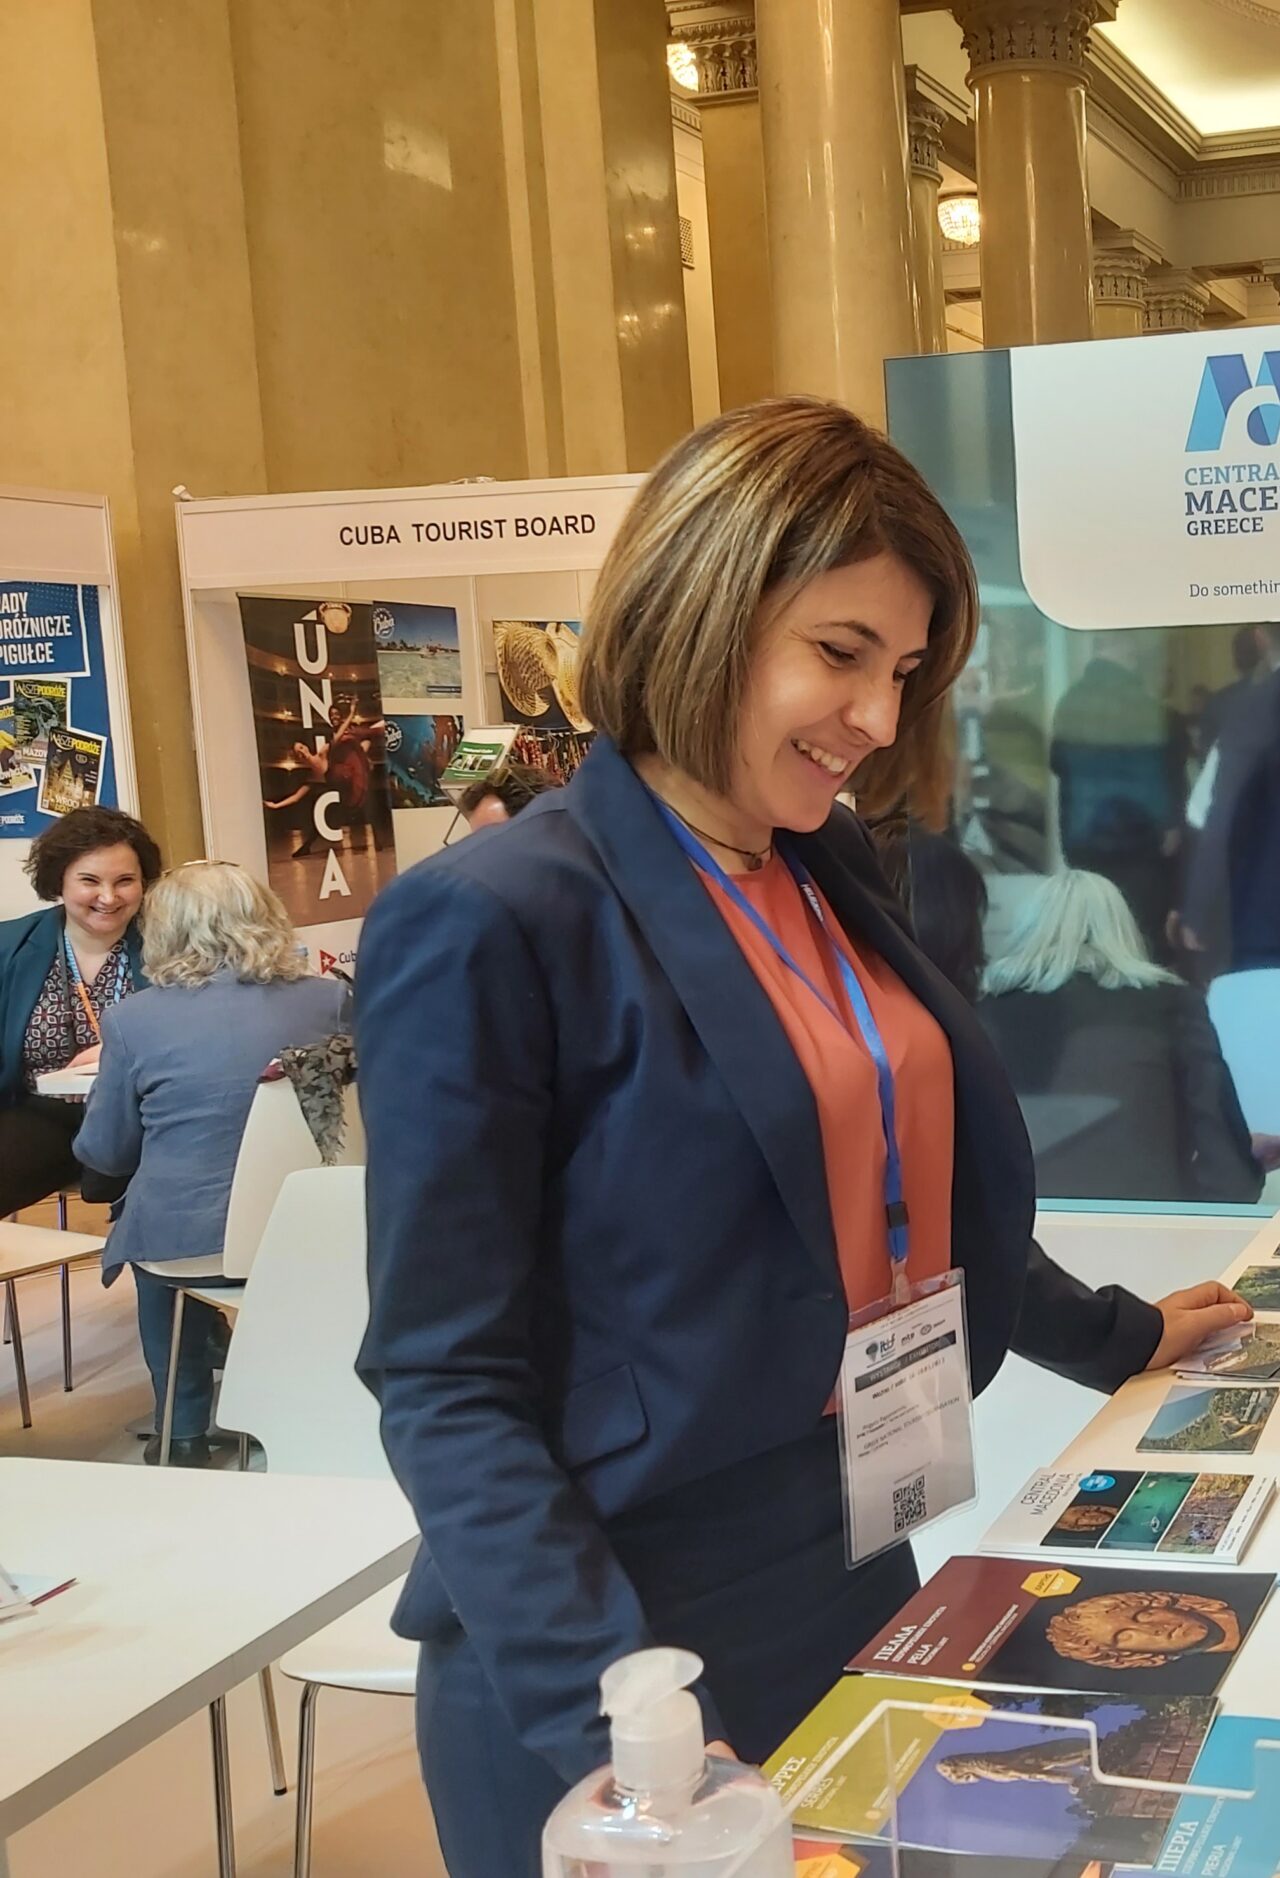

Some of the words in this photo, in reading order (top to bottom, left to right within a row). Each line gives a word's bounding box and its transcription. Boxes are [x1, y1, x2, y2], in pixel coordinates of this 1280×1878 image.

[339, 524, 401, 546] CUBA
[411, 519, 507, 542] TOURIST
[514, 514, 596, 537] BOARD
[1186, 516, 1264, 536] GREECE
[0, 592, 28, 613] ADY
[1189, 583, 1209, 597] Do
[1020, 1471, 1057, 1505] CENTRAL
[872, 1624, 918, 1661] ΠΕΛΛΑ
[906, 1643, 934, 1665] PELLA
[772, 1756, 807, 1792] ΡΡΕΣ
